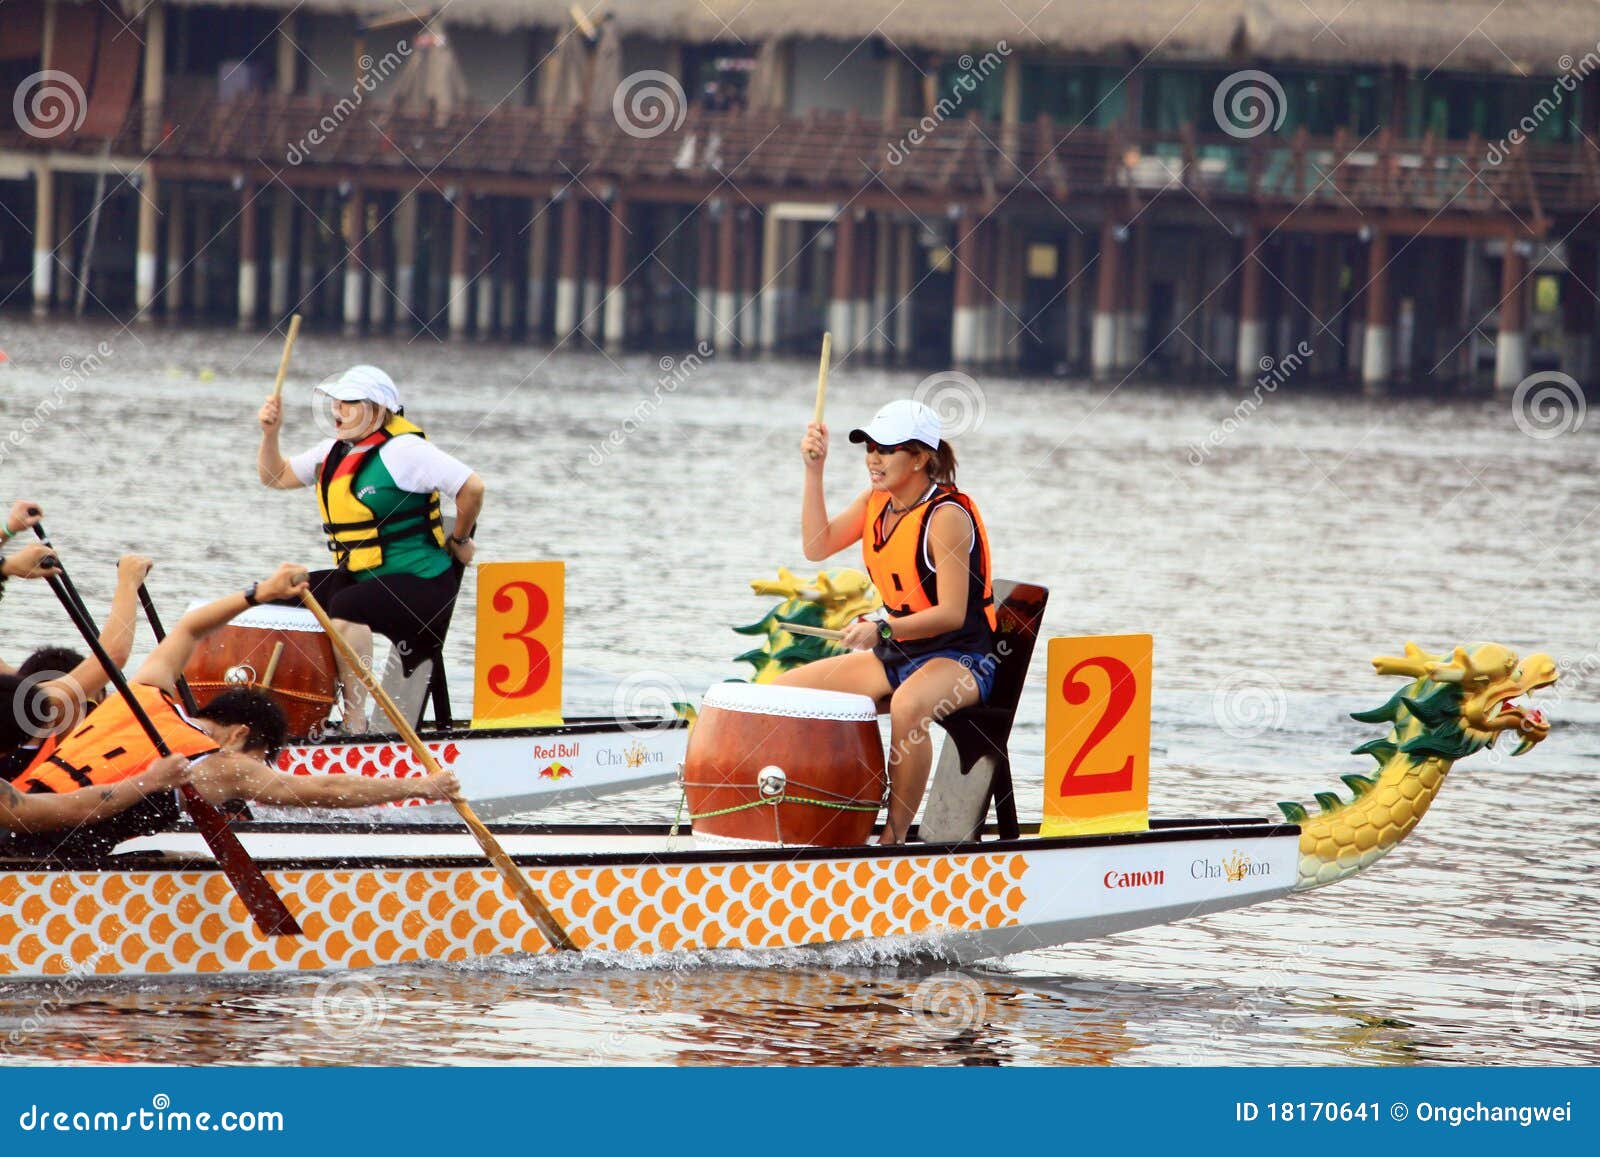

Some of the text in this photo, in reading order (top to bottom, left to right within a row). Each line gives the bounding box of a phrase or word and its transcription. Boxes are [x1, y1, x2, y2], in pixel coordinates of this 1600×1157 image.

[487, 581, 550, 698] 3
[534, 742, 580, 759] Red Bull
[1060, 656, 1136, 797] 2
[1103, 870, 1165, 889] Canon
